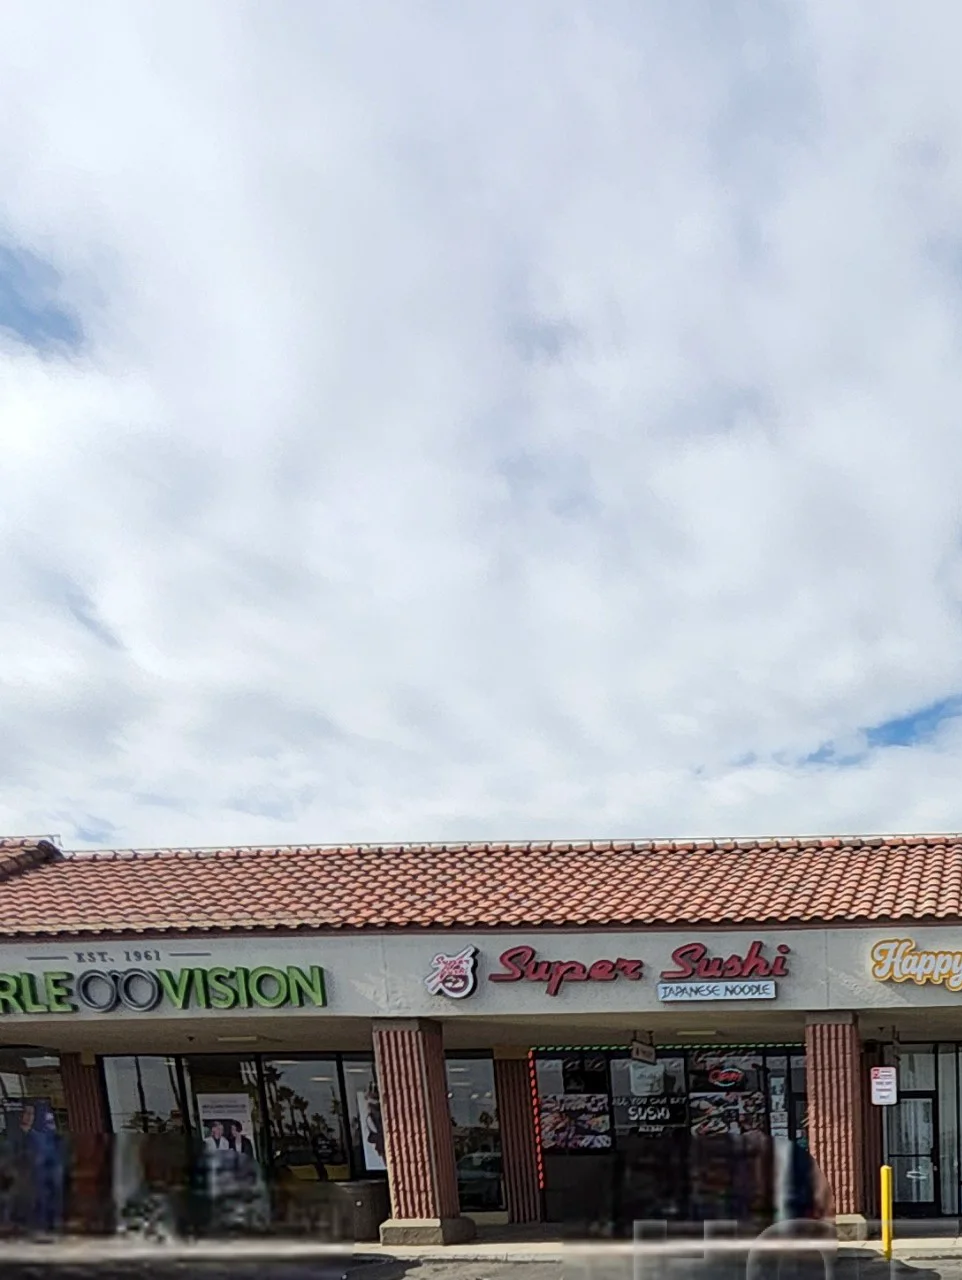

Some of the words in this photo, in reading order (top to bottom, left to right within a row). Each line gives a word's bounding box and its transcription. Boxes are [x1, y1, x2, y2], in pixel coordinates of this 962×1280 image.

[76, 952, 115, 963] EST.
[124, 950, 162, 962] 1961
[489, 945, 644, 997] Super
[660, 940, 791, 979] Sushi
[156, 965, 327, 1010] VISION
[661, 984, 721, 999] JAPANESE
[724, 983, 771, 997] NOODLE
[628, 1105, 671, 1121] SUSHI
